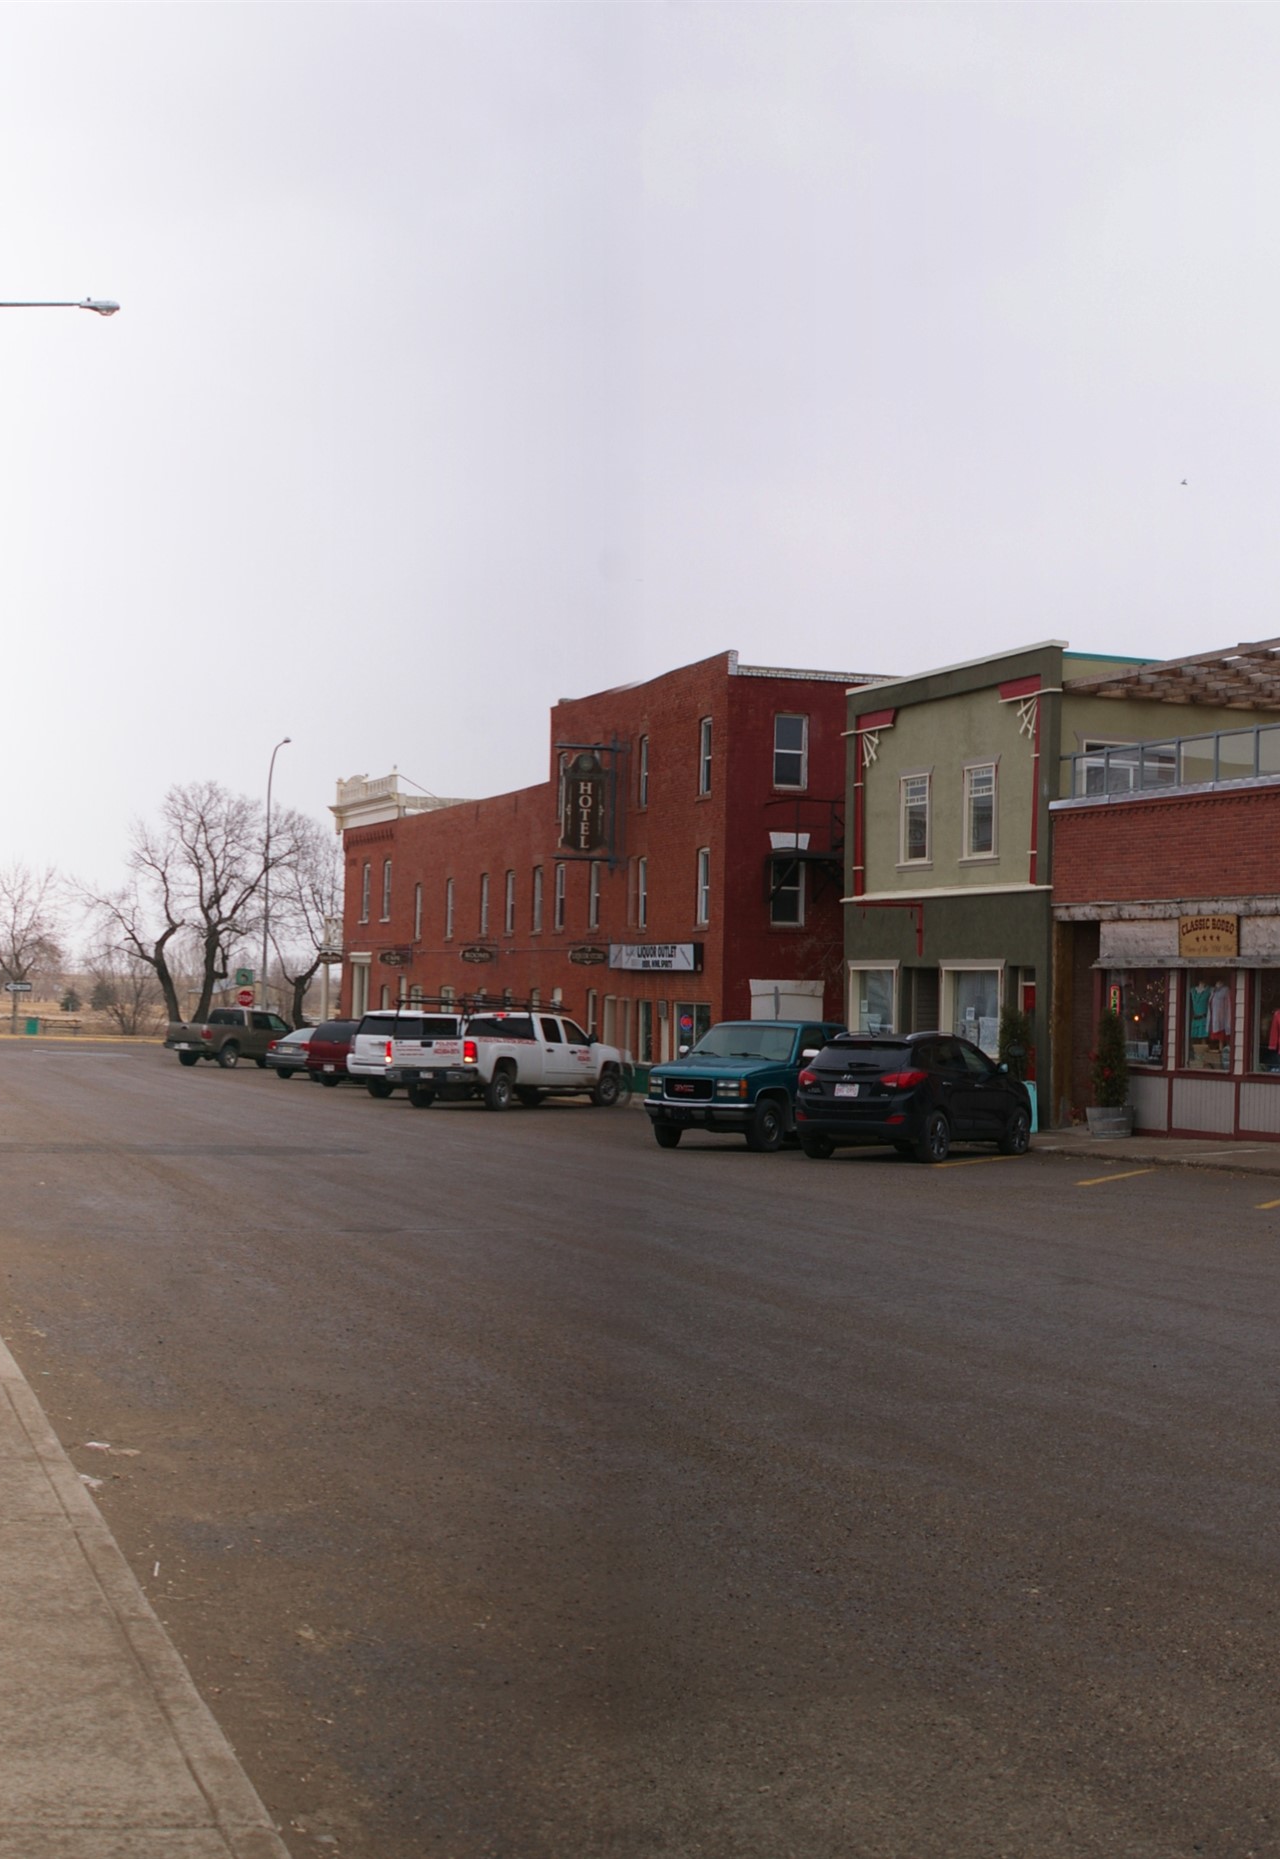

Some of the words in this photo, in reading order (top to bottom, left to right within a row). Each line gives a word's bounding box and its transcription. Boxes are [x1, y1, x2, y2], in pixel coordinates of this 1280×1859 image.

[578, 782, 593, 849] HOTEL
[1181, 918, 1210, 936] CLASSIC
[1211, 918, 1235, 935] RODEO
[637, 945, 657, 959] LIQUOR
[658, 945, 677, 958] OUTLET
